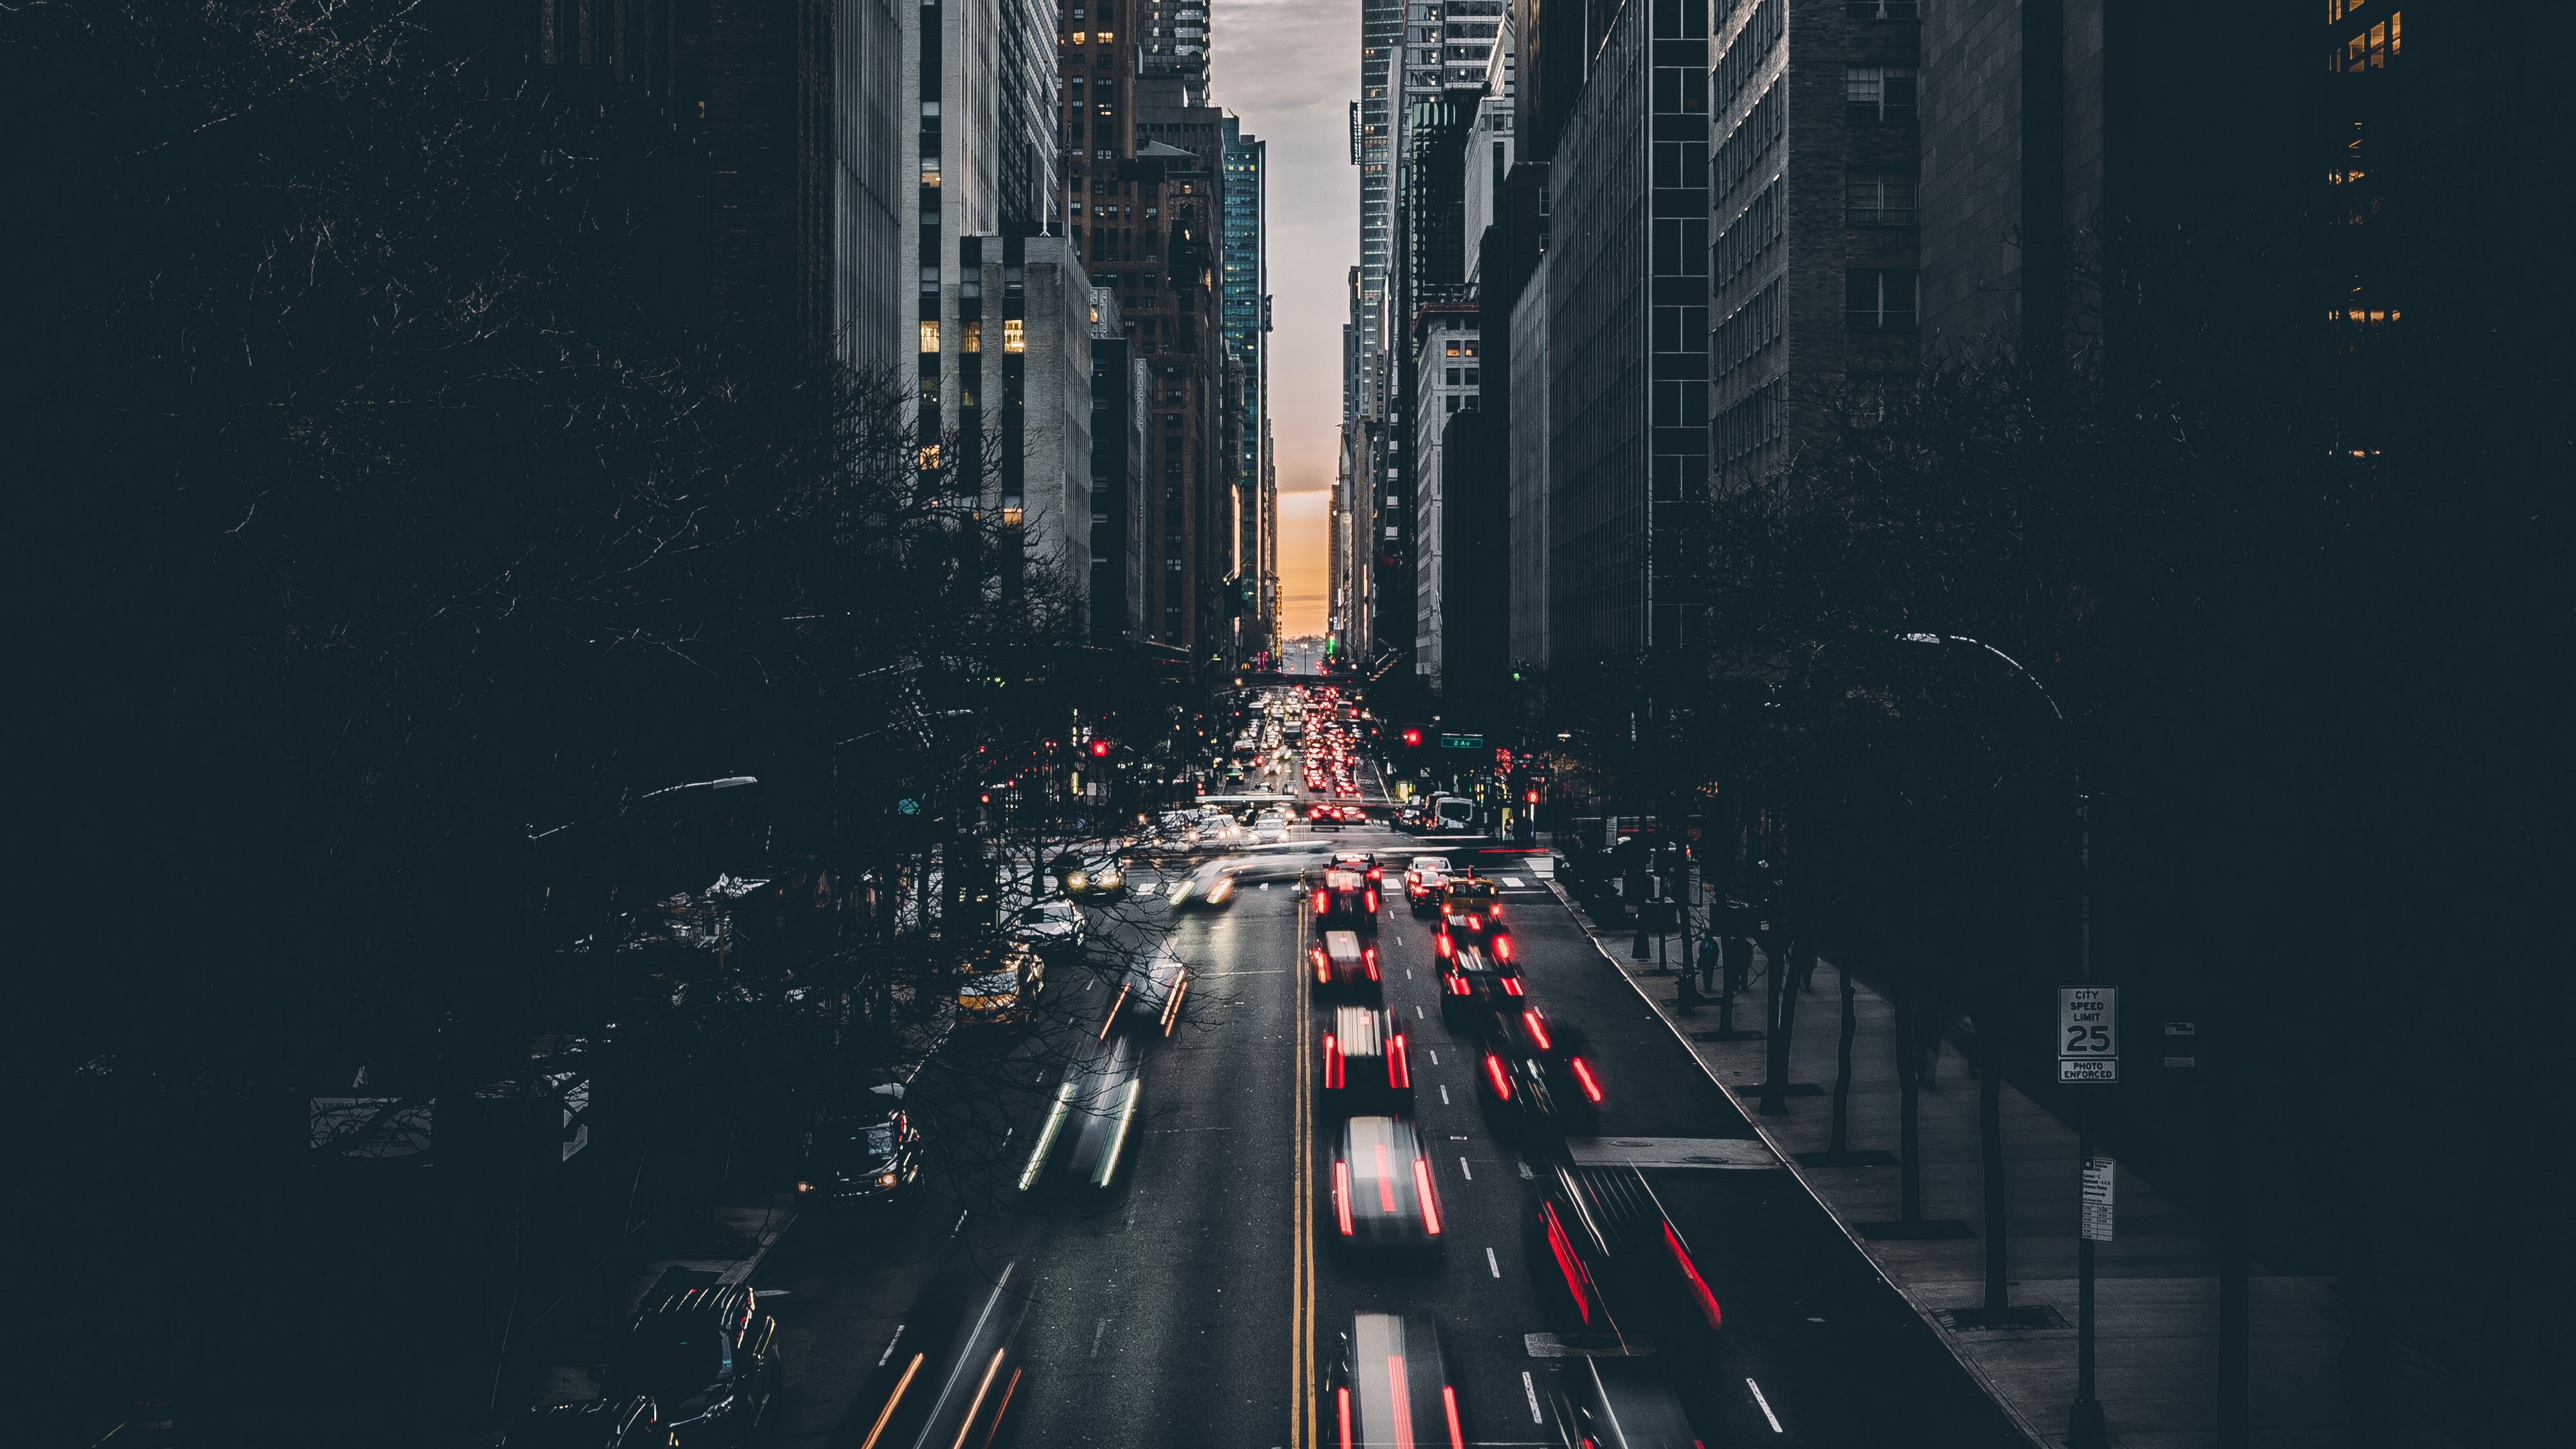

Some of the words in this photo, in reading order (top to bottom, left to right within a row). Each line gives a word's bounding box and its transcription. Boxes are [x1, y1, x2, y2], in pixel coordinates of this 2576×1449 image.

[2075, 990, 2099, 1000] CITY
[2070, 1002, 2104, 1011] SPEED
[2074, 1013, 2101, 1022] LIMIT
[2066, 1025, 2110, 1052] 25
[2073, 1062, 2103, 1070] PHOTO
[2064, 1070, 2112, 1079] ENFORCED
